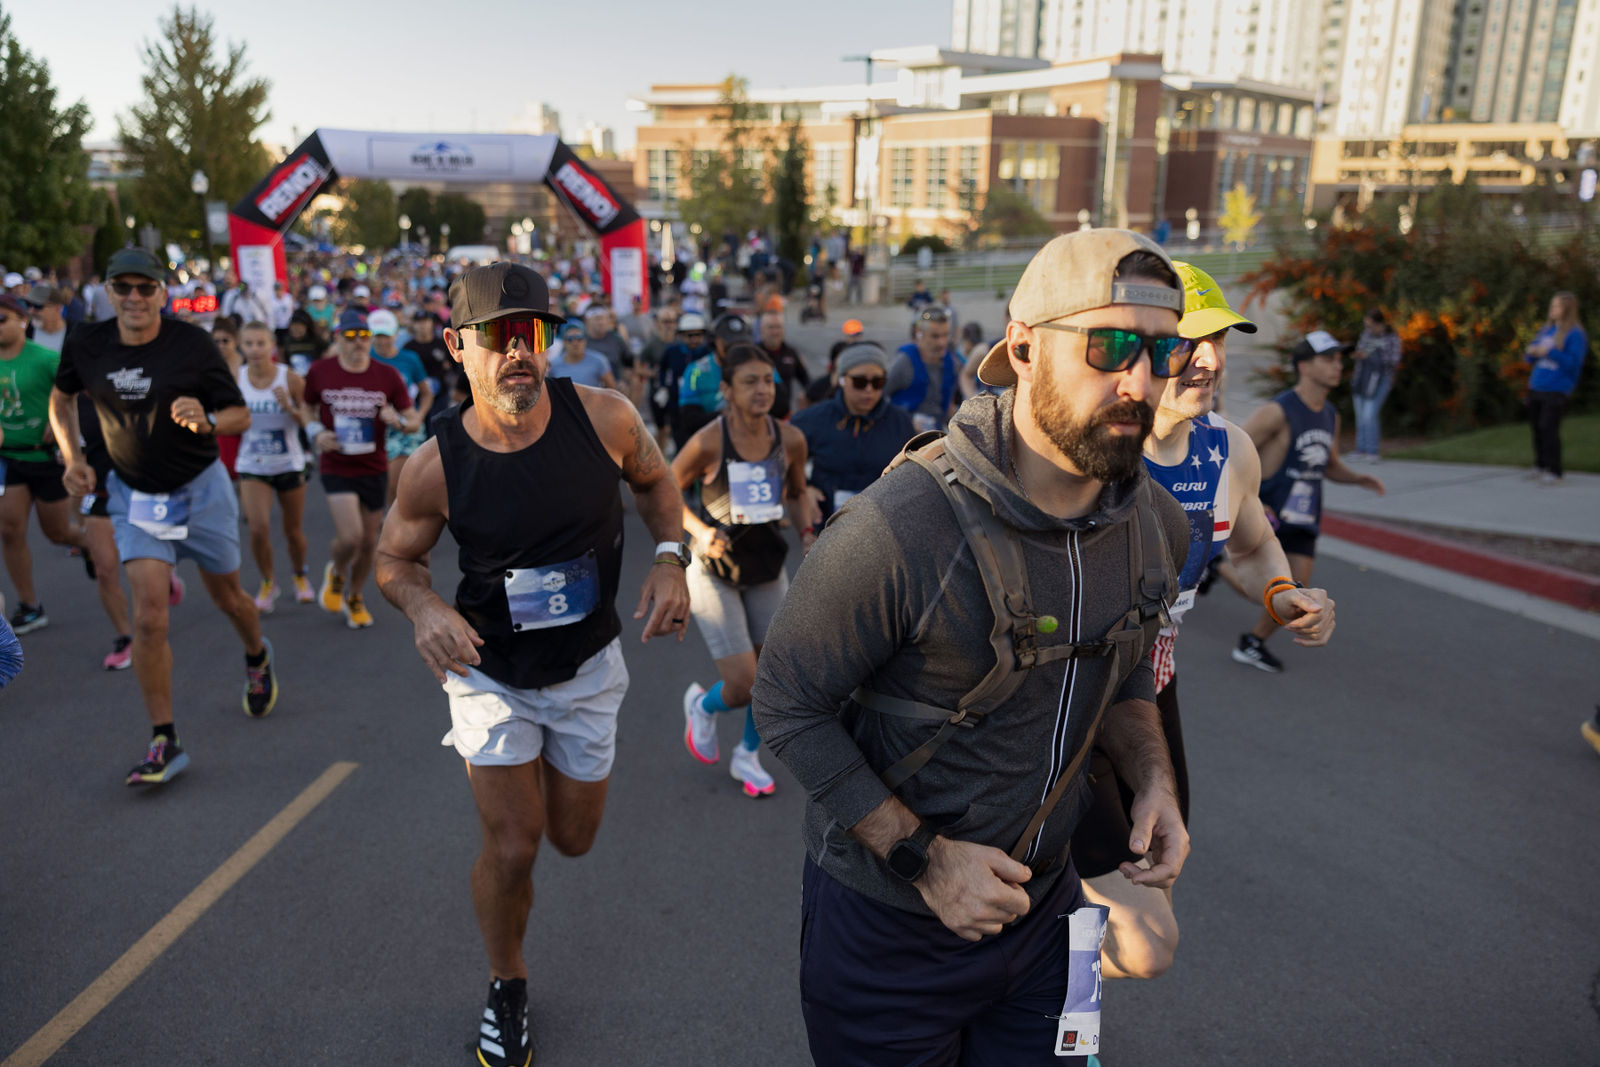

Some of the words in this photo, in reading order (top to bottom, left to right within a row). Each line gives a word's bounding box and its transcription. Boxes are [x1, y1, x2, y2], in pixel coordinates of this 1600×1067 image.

[257, 163, 318, 222] RENO
[748, 483, 772, 503] 33
[1172, 481, 1208, 492] GURU
[153, 503, 168, 521] 9
[548, 594, 569, 615] 8
